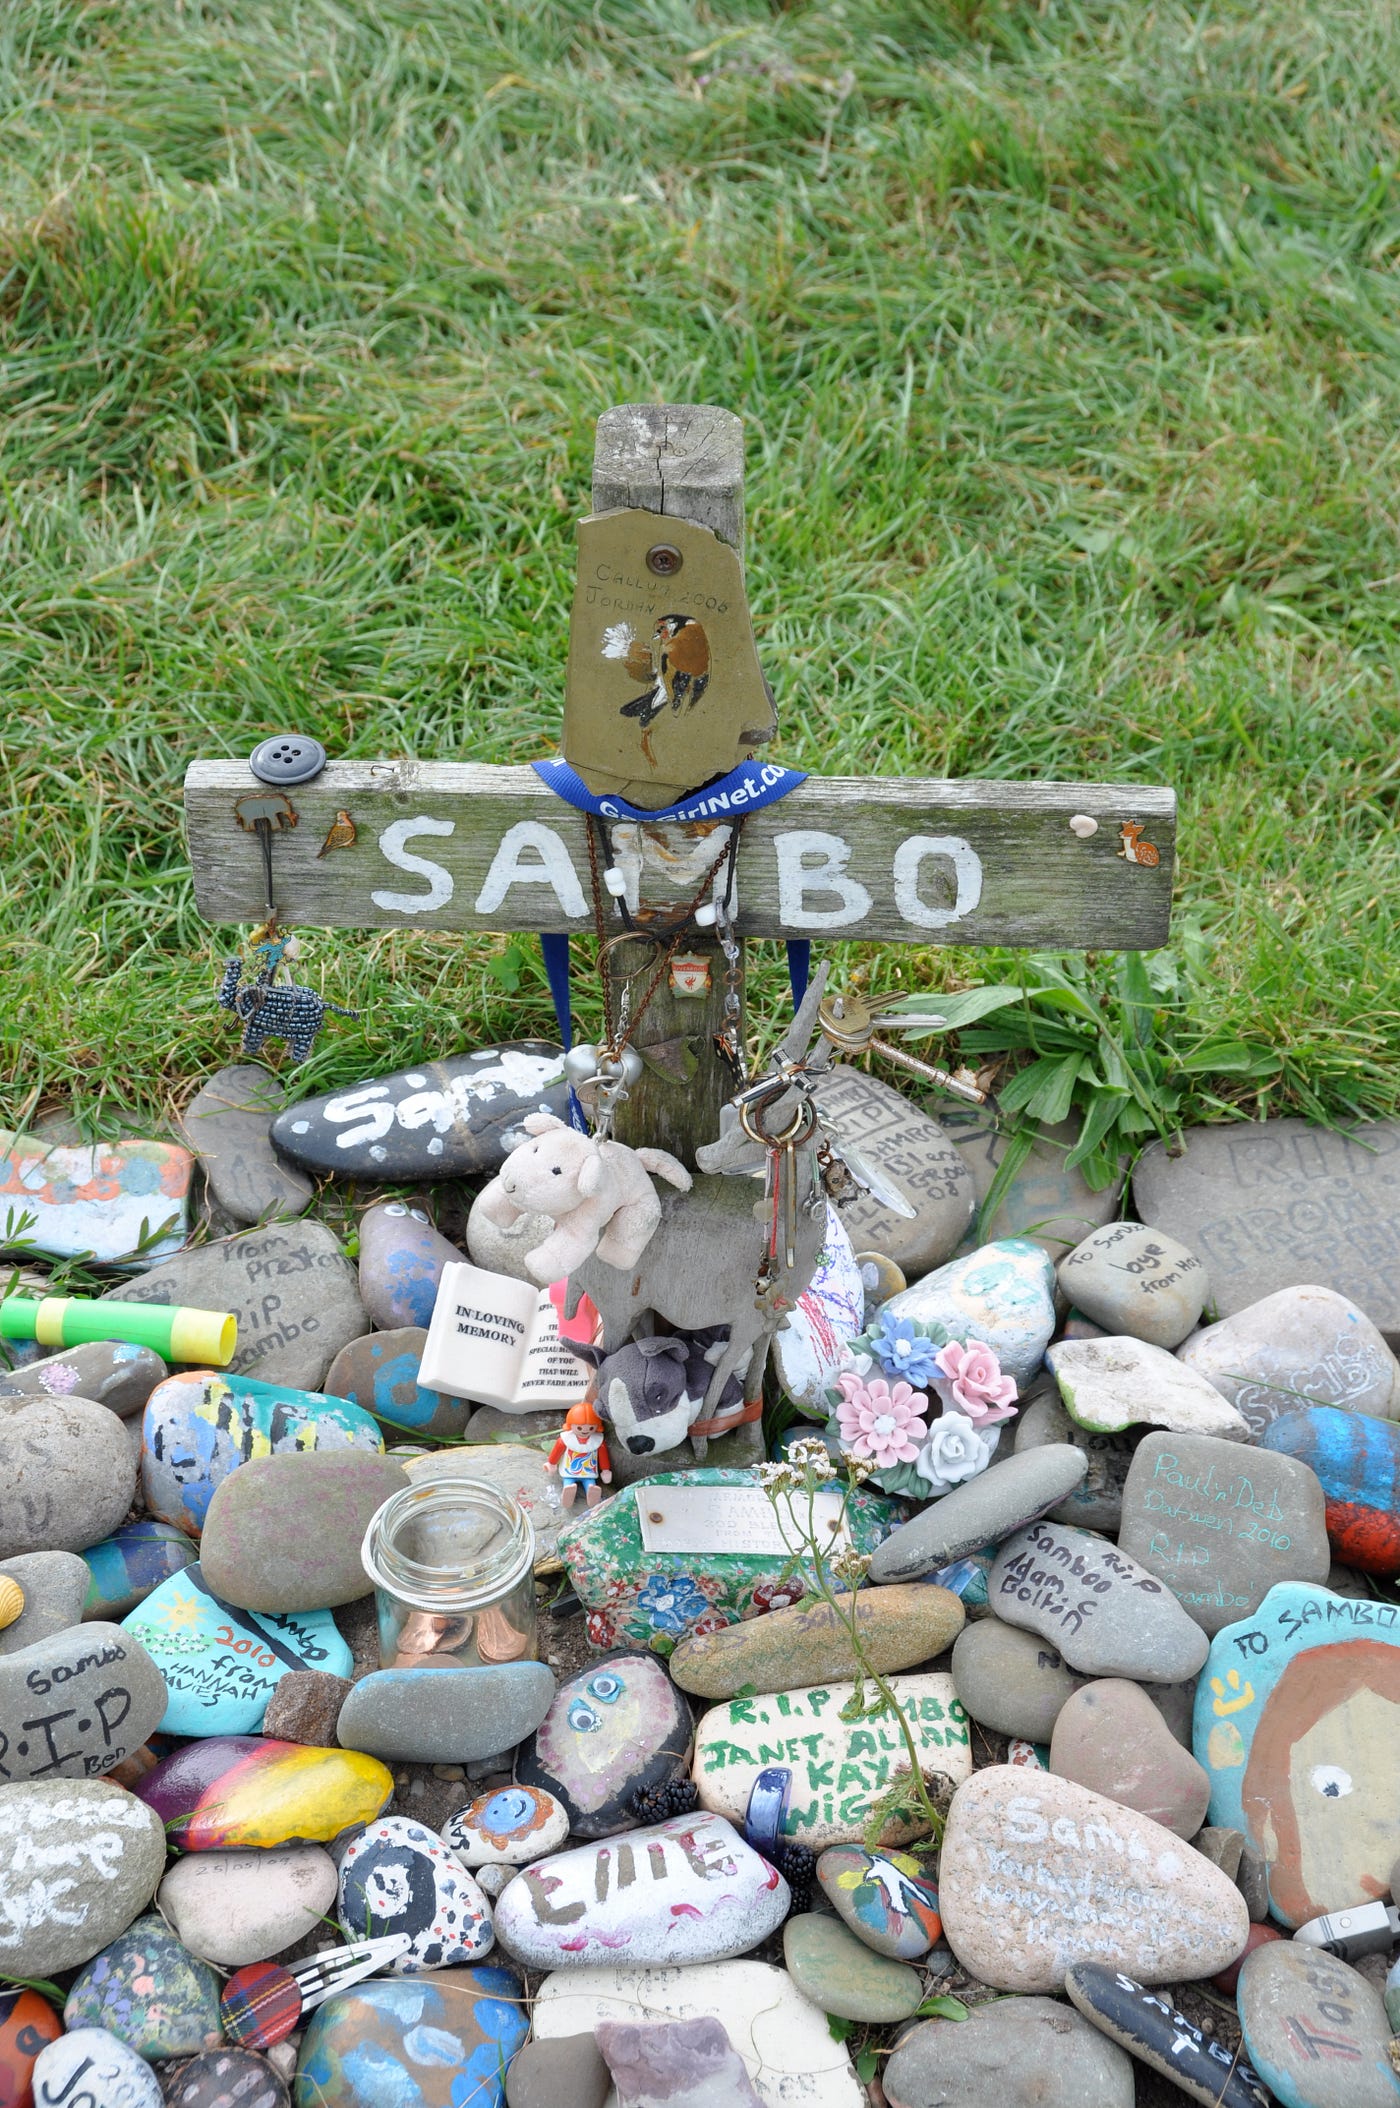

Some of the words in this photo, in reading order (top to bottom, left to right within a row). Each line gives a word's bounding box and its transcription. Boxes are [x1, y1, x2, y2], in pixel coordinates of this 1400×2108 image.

[455, 1305, 472, 1319] IN
[474, 1311, 526, 1335] LOVING
[457, 1323, 517, 1347] MEMORY
[1153, 1453, 1215, 1497] Paul
[1238, 1522, 1292, 1551] 2010
[214, 1625, 277, 1667] 2010
[1233, 1631, 1269, 1659] TO
[1278, 1601, 1399, 1642] SAMBO
[170, 1663, 259, 1701] HANNAH
[83, 1746, 126, 1776] Ben
[701, 1732, 825, 1773] JANET
[846, 1726, 970, 1759] ALLAN
[806, 1755, 890, 1794] KAY
